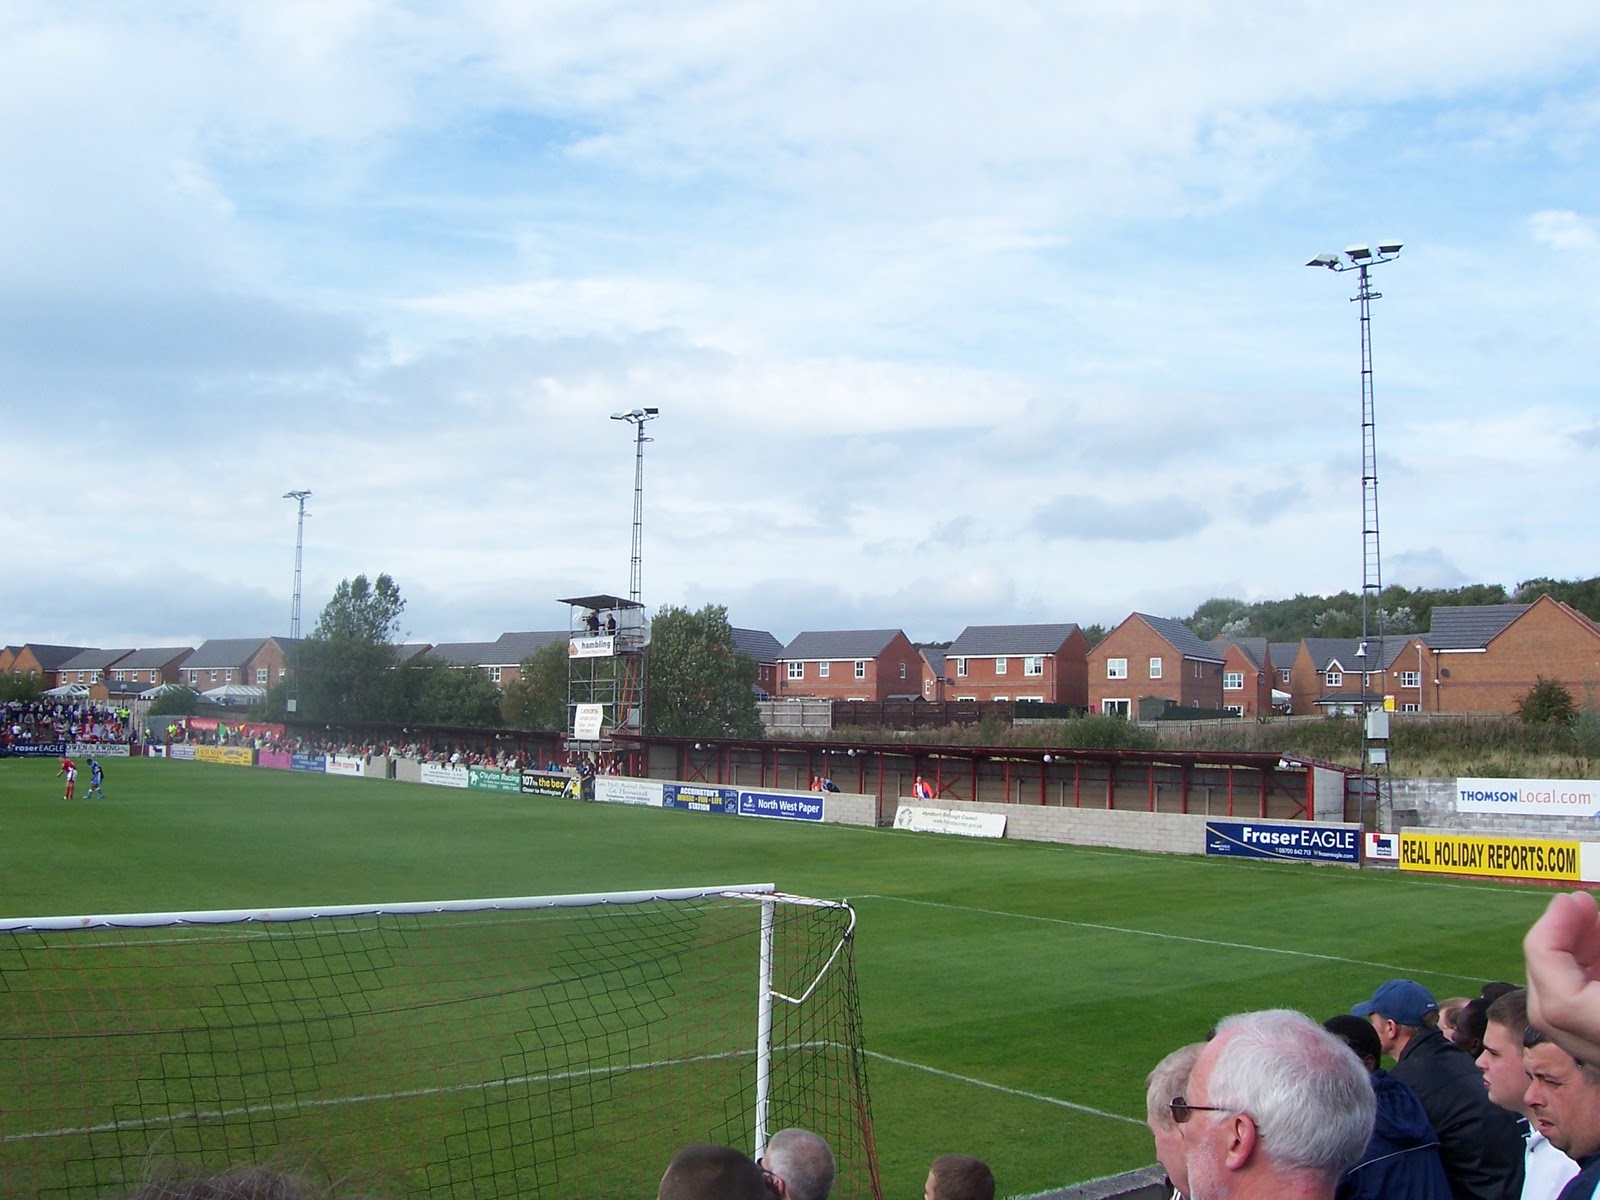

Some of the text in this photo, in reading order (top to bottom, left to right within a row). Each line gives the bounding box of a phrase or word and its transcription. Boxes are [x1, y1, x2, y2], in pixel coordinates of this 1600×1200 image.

[581, 640, 611, 649] hambling
[480, 771, 500, 781] Clayton
[501, 773, 520, 784] Racing
[539, 777, 551, 788] the
[551, 778, 565, 789] bee
[680, 786, 720, 798] ACCRINGTON'S
[688, 802, 710, 811] STATION
[711, 797, 723, 805] LIFE
[758, 798, 779, 810] North
[779, 800, 798, 812] West
[798, 802, 820, 815] Paper
[943, 811, 961, 820] Borough
[1402, 839, 1577, 874] REAL HOLIDAY REPORTS.COM
